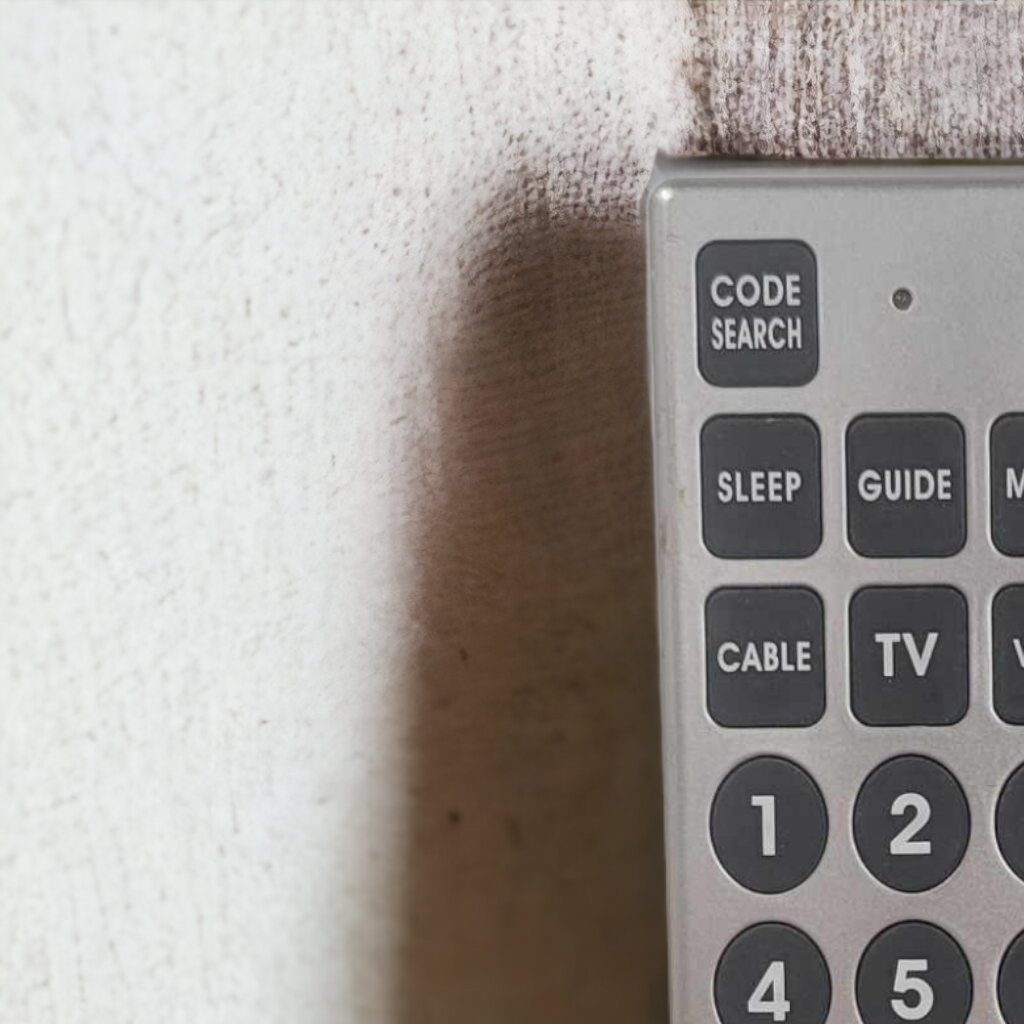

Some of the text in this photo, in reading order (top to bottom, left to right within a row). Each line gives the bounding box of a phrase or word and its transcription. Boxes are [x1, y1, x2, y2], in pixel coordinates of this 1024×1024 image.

[711, 275, 800, 306] CODE
[712, 318, 801, 349] SEARCH
[718, 471, 800, 502] SLEEP
[859, 470, 951, 500] GUIDE
[718, 642, 810, 672] CABLE
[875, 633, 938, 676] TV
[752, 796, 775, 855] 1
[891, 793, 930, 854] 2
[748, 962, 790, 1020] 4
[892, 960, 933, 1019] 5
